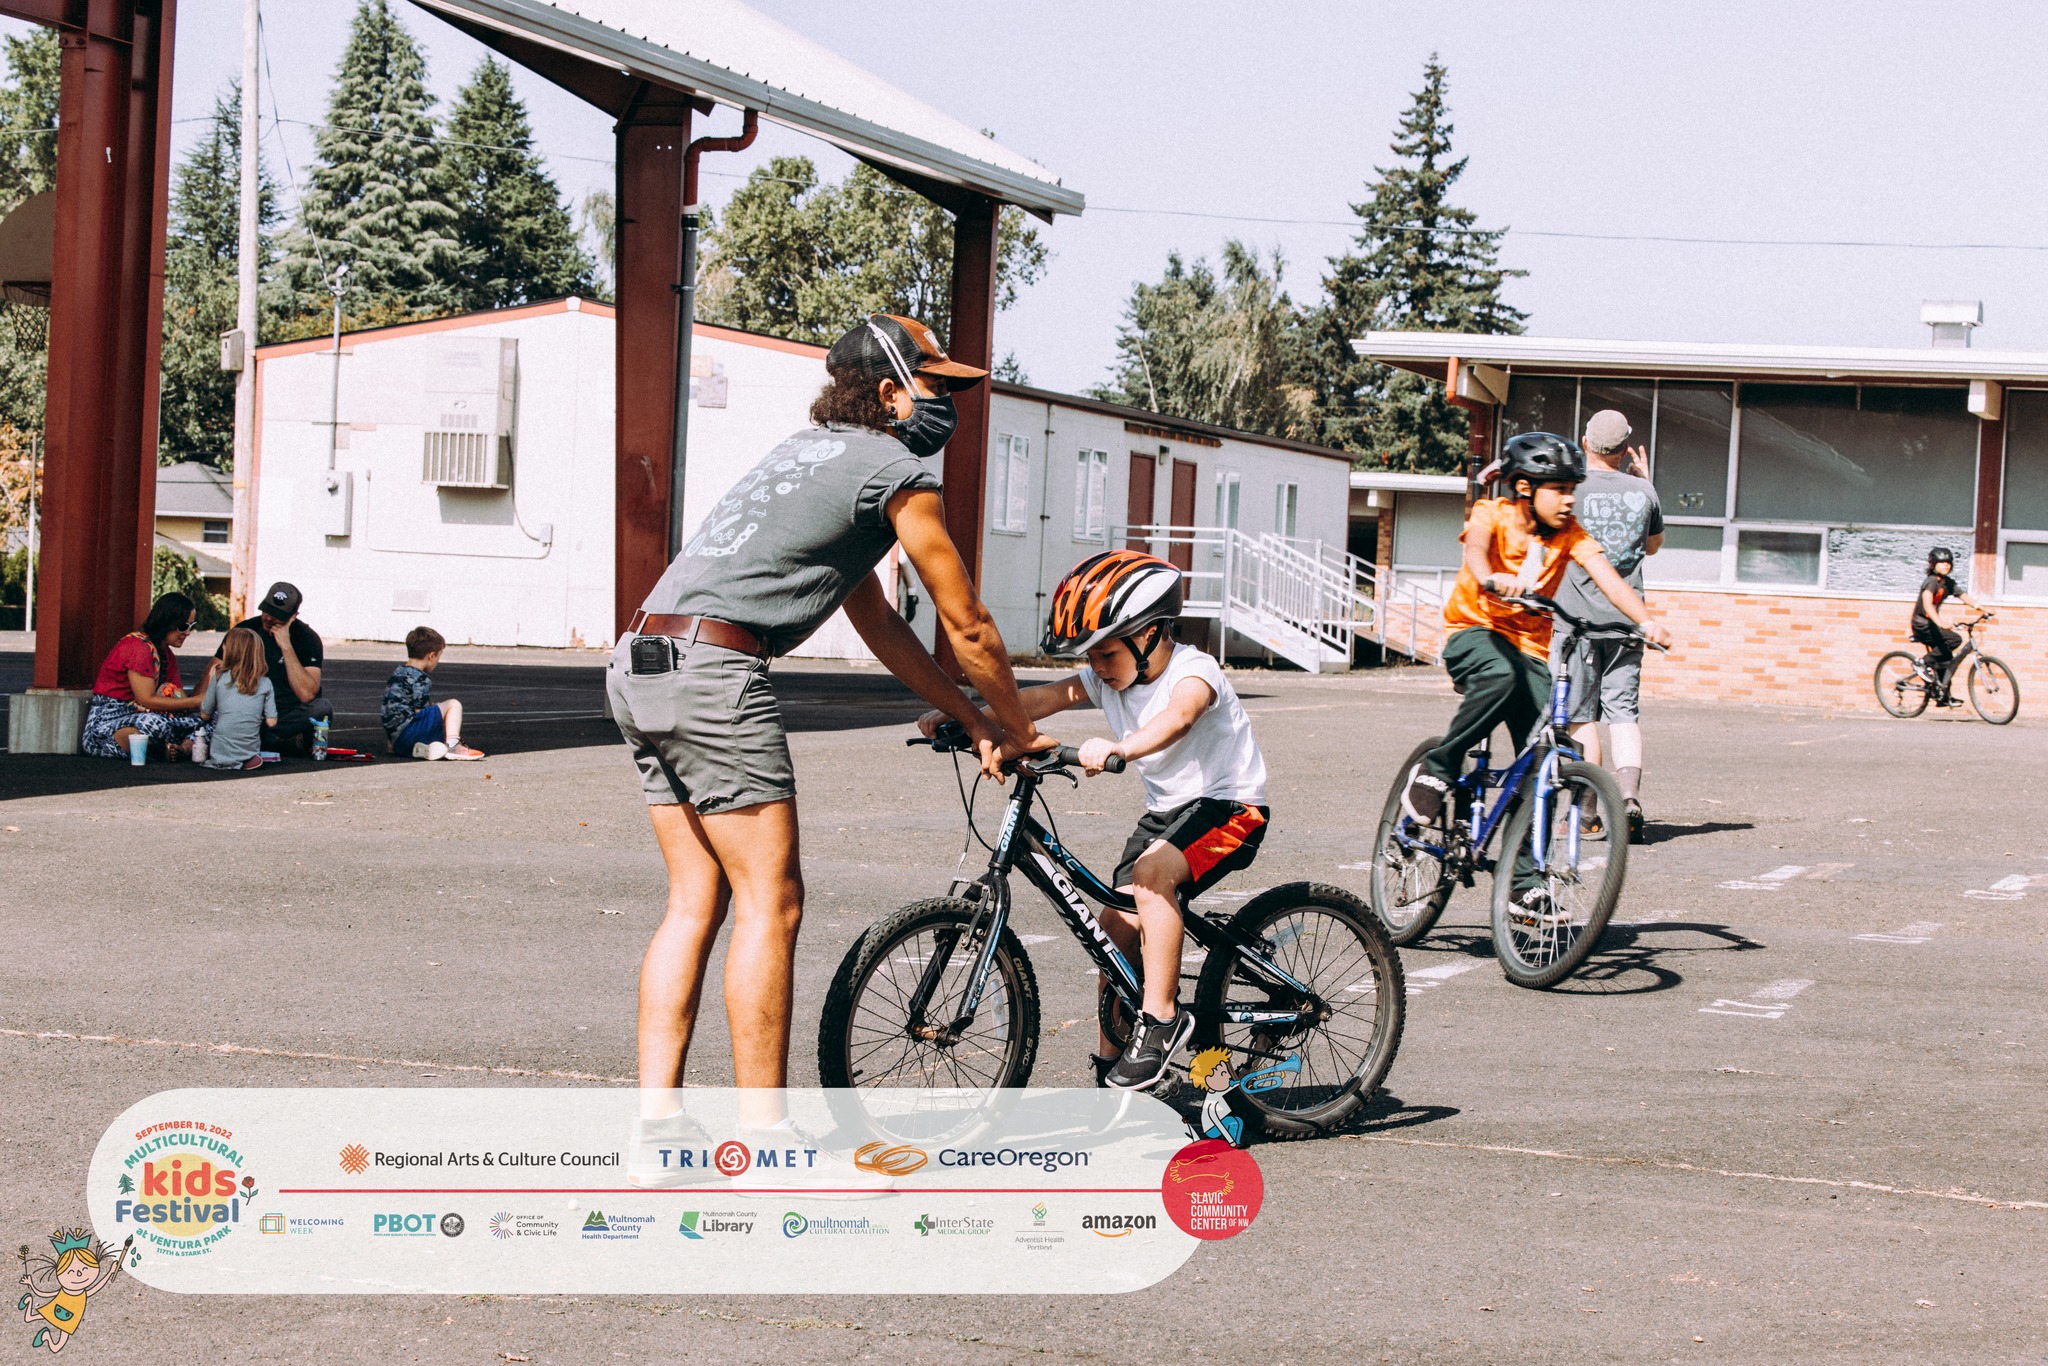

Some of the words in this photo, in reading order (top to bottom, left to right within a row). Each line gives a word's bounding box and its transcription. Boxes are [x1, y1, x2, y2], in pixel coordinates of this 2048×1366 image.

[1000, 802, 1020, 852] GIANT
[1052, 872, 1121, 955] GIANT
[1012, 957, 1033, 1000] GIANT
